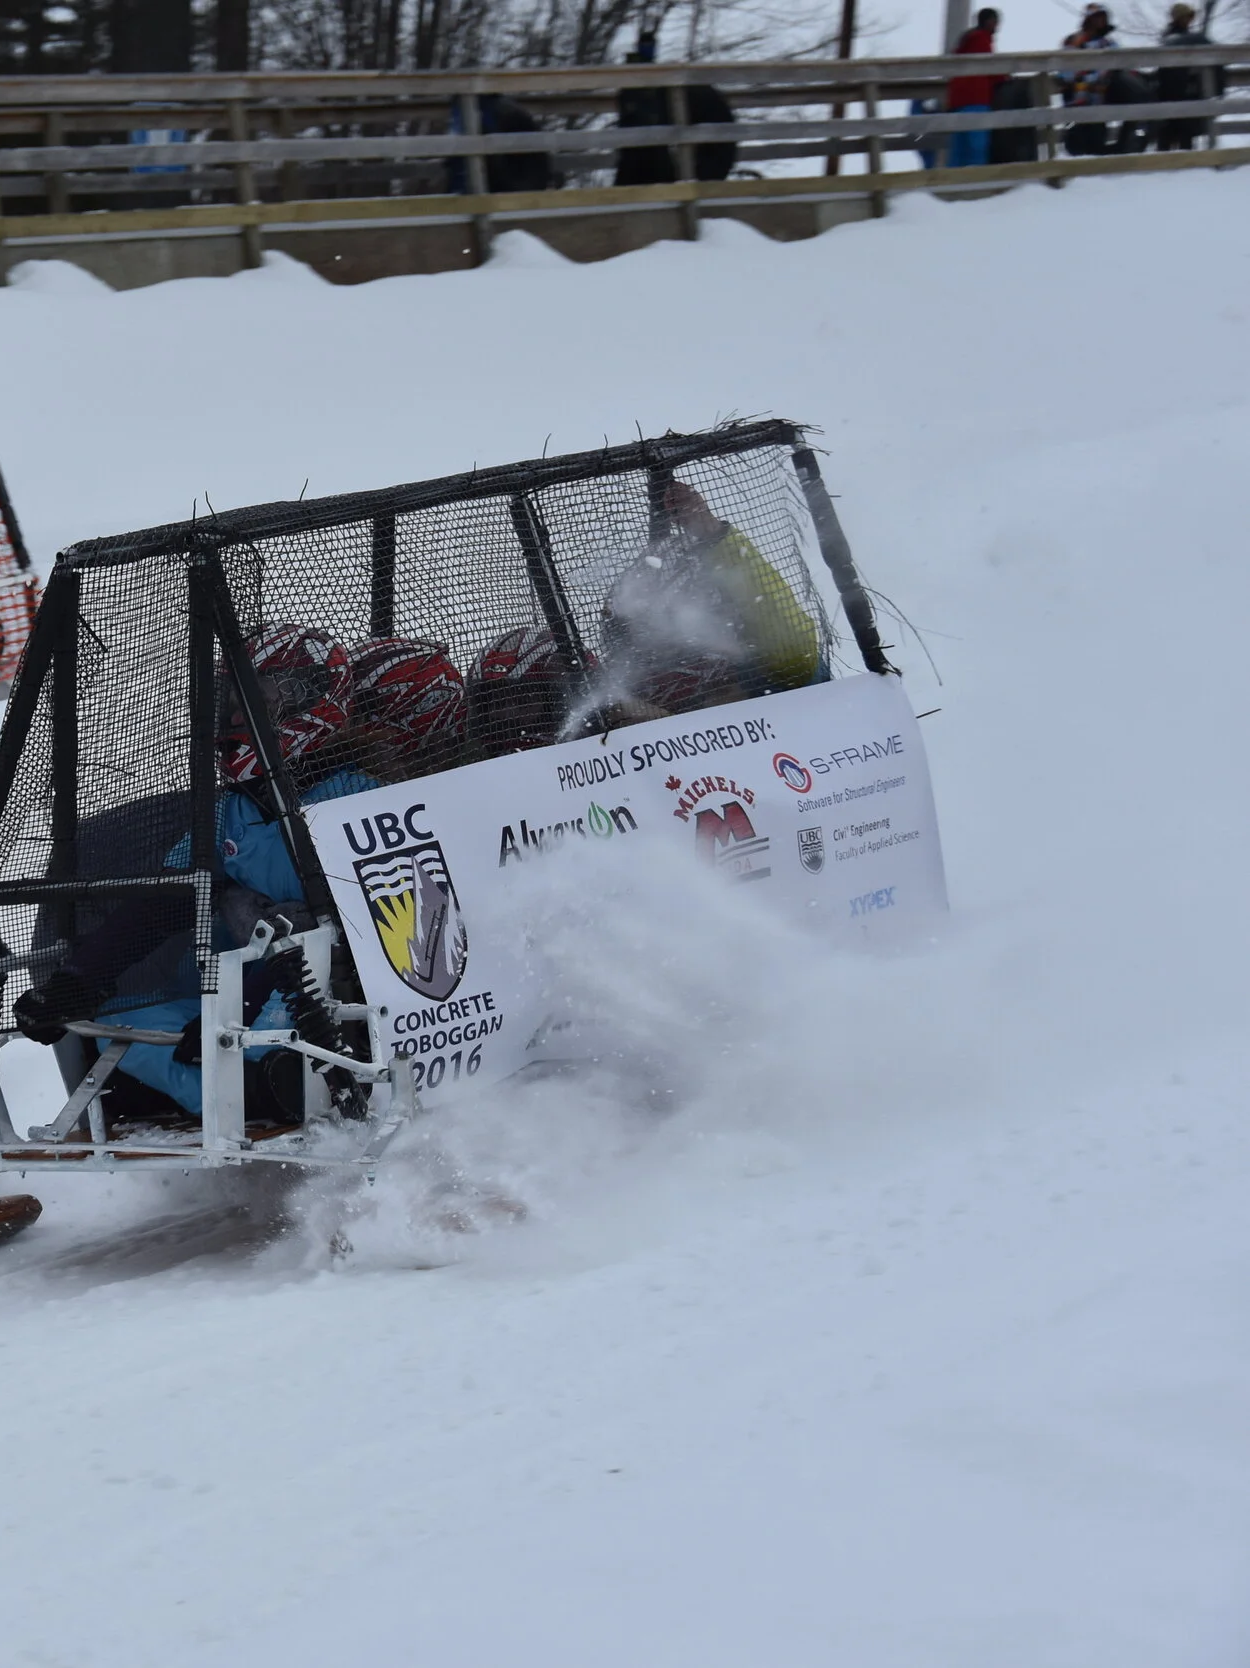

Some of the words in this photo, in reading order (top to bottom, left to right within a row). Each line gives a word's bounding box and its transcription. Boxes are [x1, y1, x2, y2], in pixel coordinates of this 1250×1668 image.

[557, 751, 626, 791] PROUDLY
[630, 724, 743, 772] SPONSORED
[743, 718, 776, 744] BY:
[809, 734, 905, 775] S-FRAME
[673, 776, 755, 823] MICHELS
[797, 796, 832, 813] Software
[833, 791, 843, 804] for
[844, 781, 876, 801] Structural
[876, 775, 906, 793] Engineers
[342, 804, 435, 856] UBC
[800, 830, 823, 844] UBC
[835, 847, 859, 861] Faculty
[859, 842, 867, 855] of
[867, 834, 893, 853] Applied
[893, 830, 920, 845] Science
[850, 817, 891, 837] Engineering
[393, 991, 496, 1034] CONCRETE
[391, 1014, 503, 1056] TOBOGGAN
[411, 1043, 483, 1091] 2016
